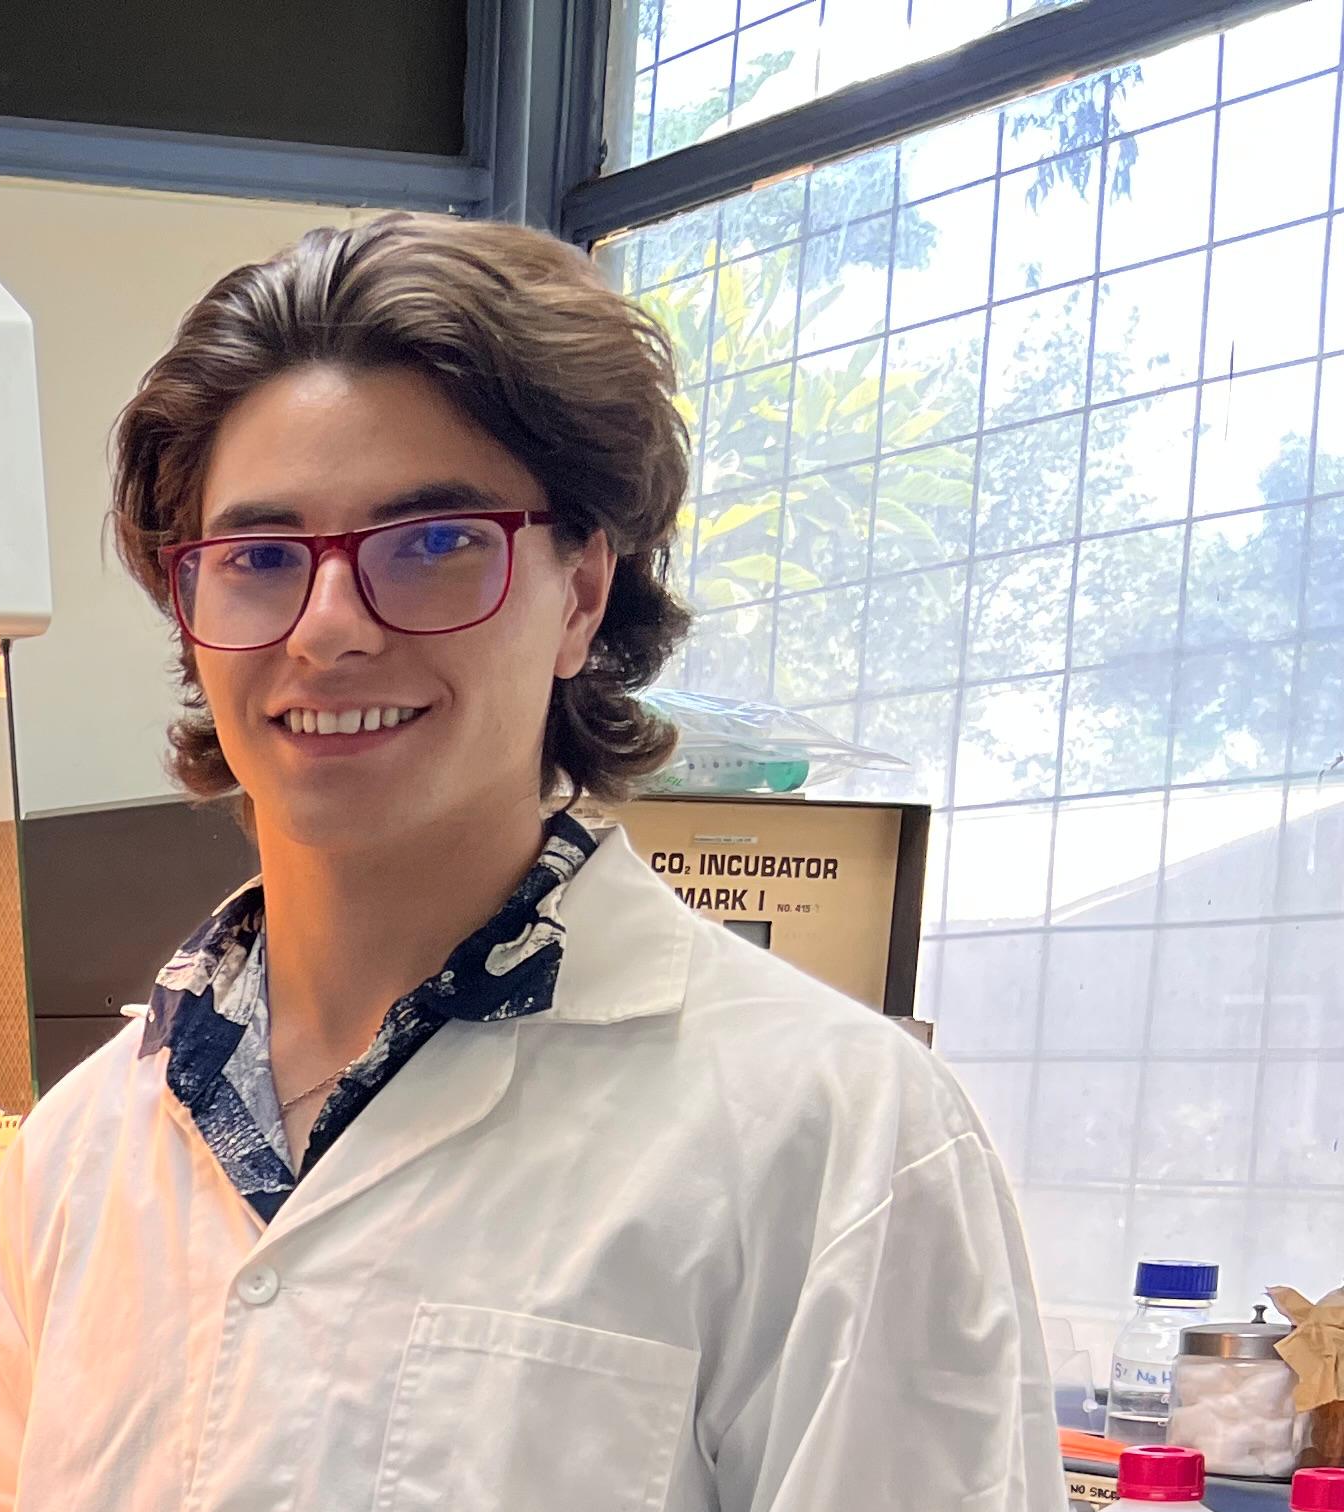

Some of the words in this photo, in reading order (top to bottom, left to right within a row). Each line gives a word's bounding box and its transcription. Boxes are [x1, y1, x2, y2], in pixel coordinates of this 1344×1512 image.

[699, 853, 838, 880] INCUBATOR
[674, 887, 748, 911] MARK
[1070, 1484, 1086, 1494] NO
